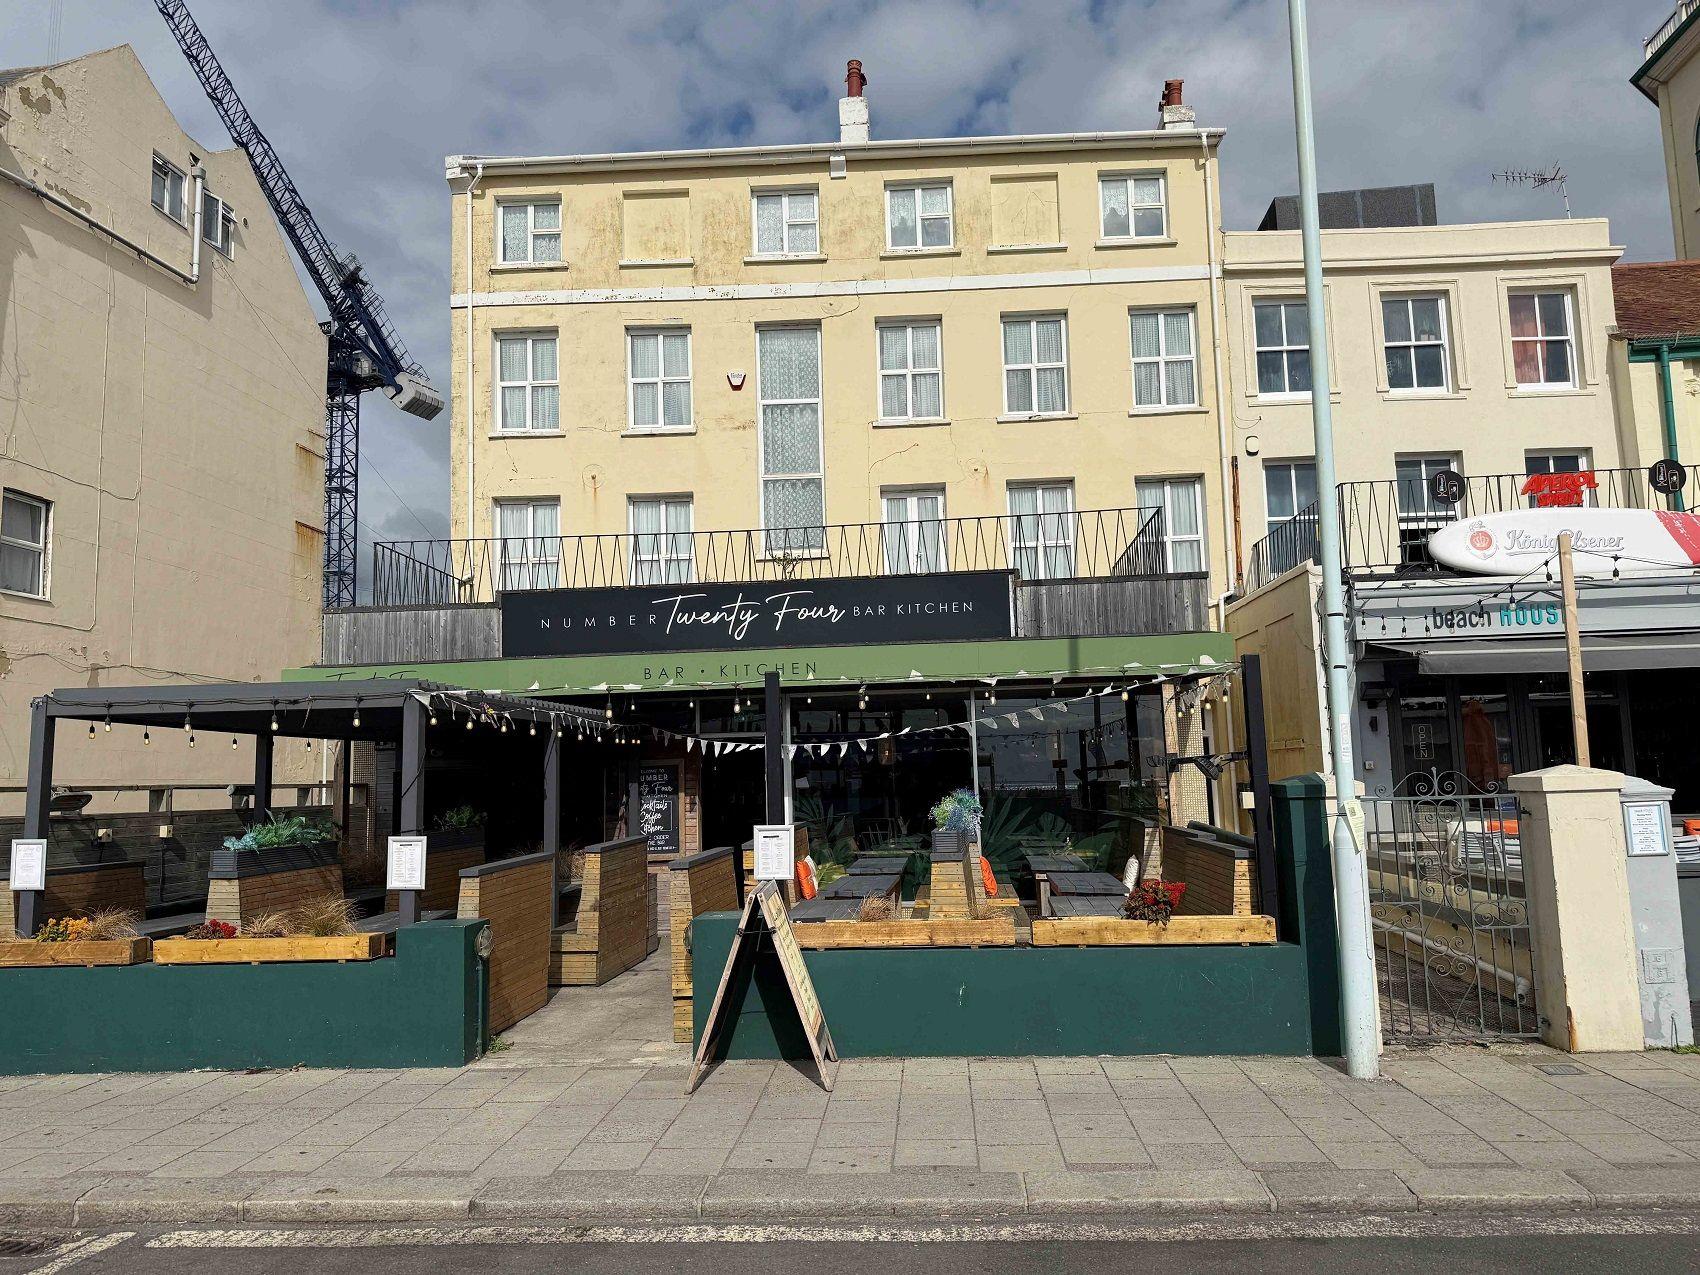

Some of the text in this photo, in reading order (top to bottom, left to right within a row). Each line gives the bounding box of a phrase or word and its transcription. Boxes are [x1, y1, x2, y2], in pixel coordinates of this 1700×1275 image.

[1520, 471, 1599, 495] APEROL
[541, 590, 974, 641] NUMBER Twenty Four BAR KITCHEN
[1432, 602, 1567, 630] beach HOUS
[644, 661, 817, 680] BAR KITCHEN
[640, 774, 669, 782] UMBER
